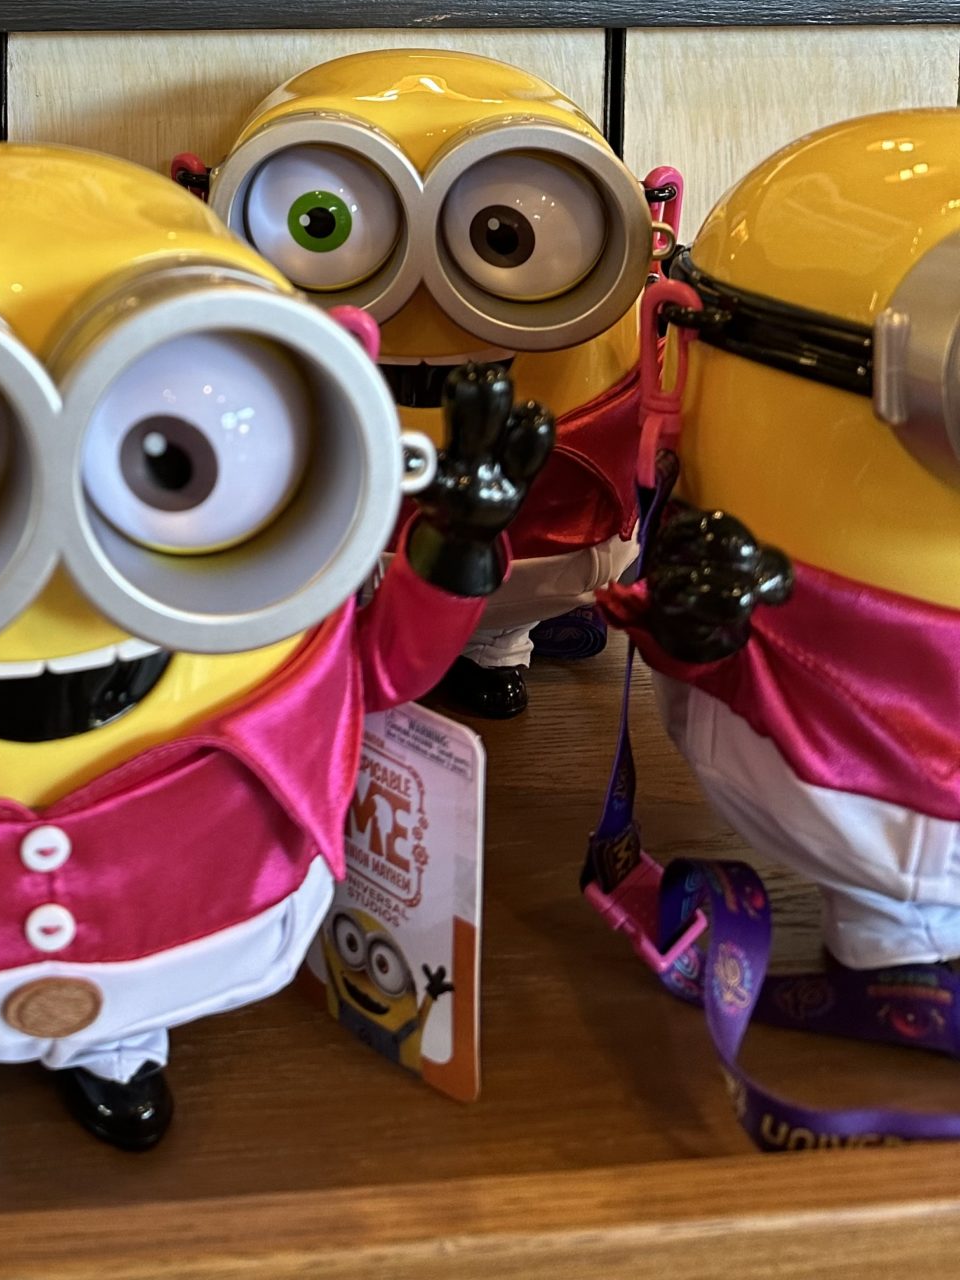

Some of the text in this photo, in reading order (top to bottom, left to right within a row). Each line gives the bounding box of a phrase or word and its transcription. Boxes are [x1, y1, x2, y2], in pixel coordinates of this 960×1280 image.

[360, 754, 411, 799] PICABLE
[347, 885, 400, 928] STUDIOS
[348, 873, 410, 922] NIVERSAL
